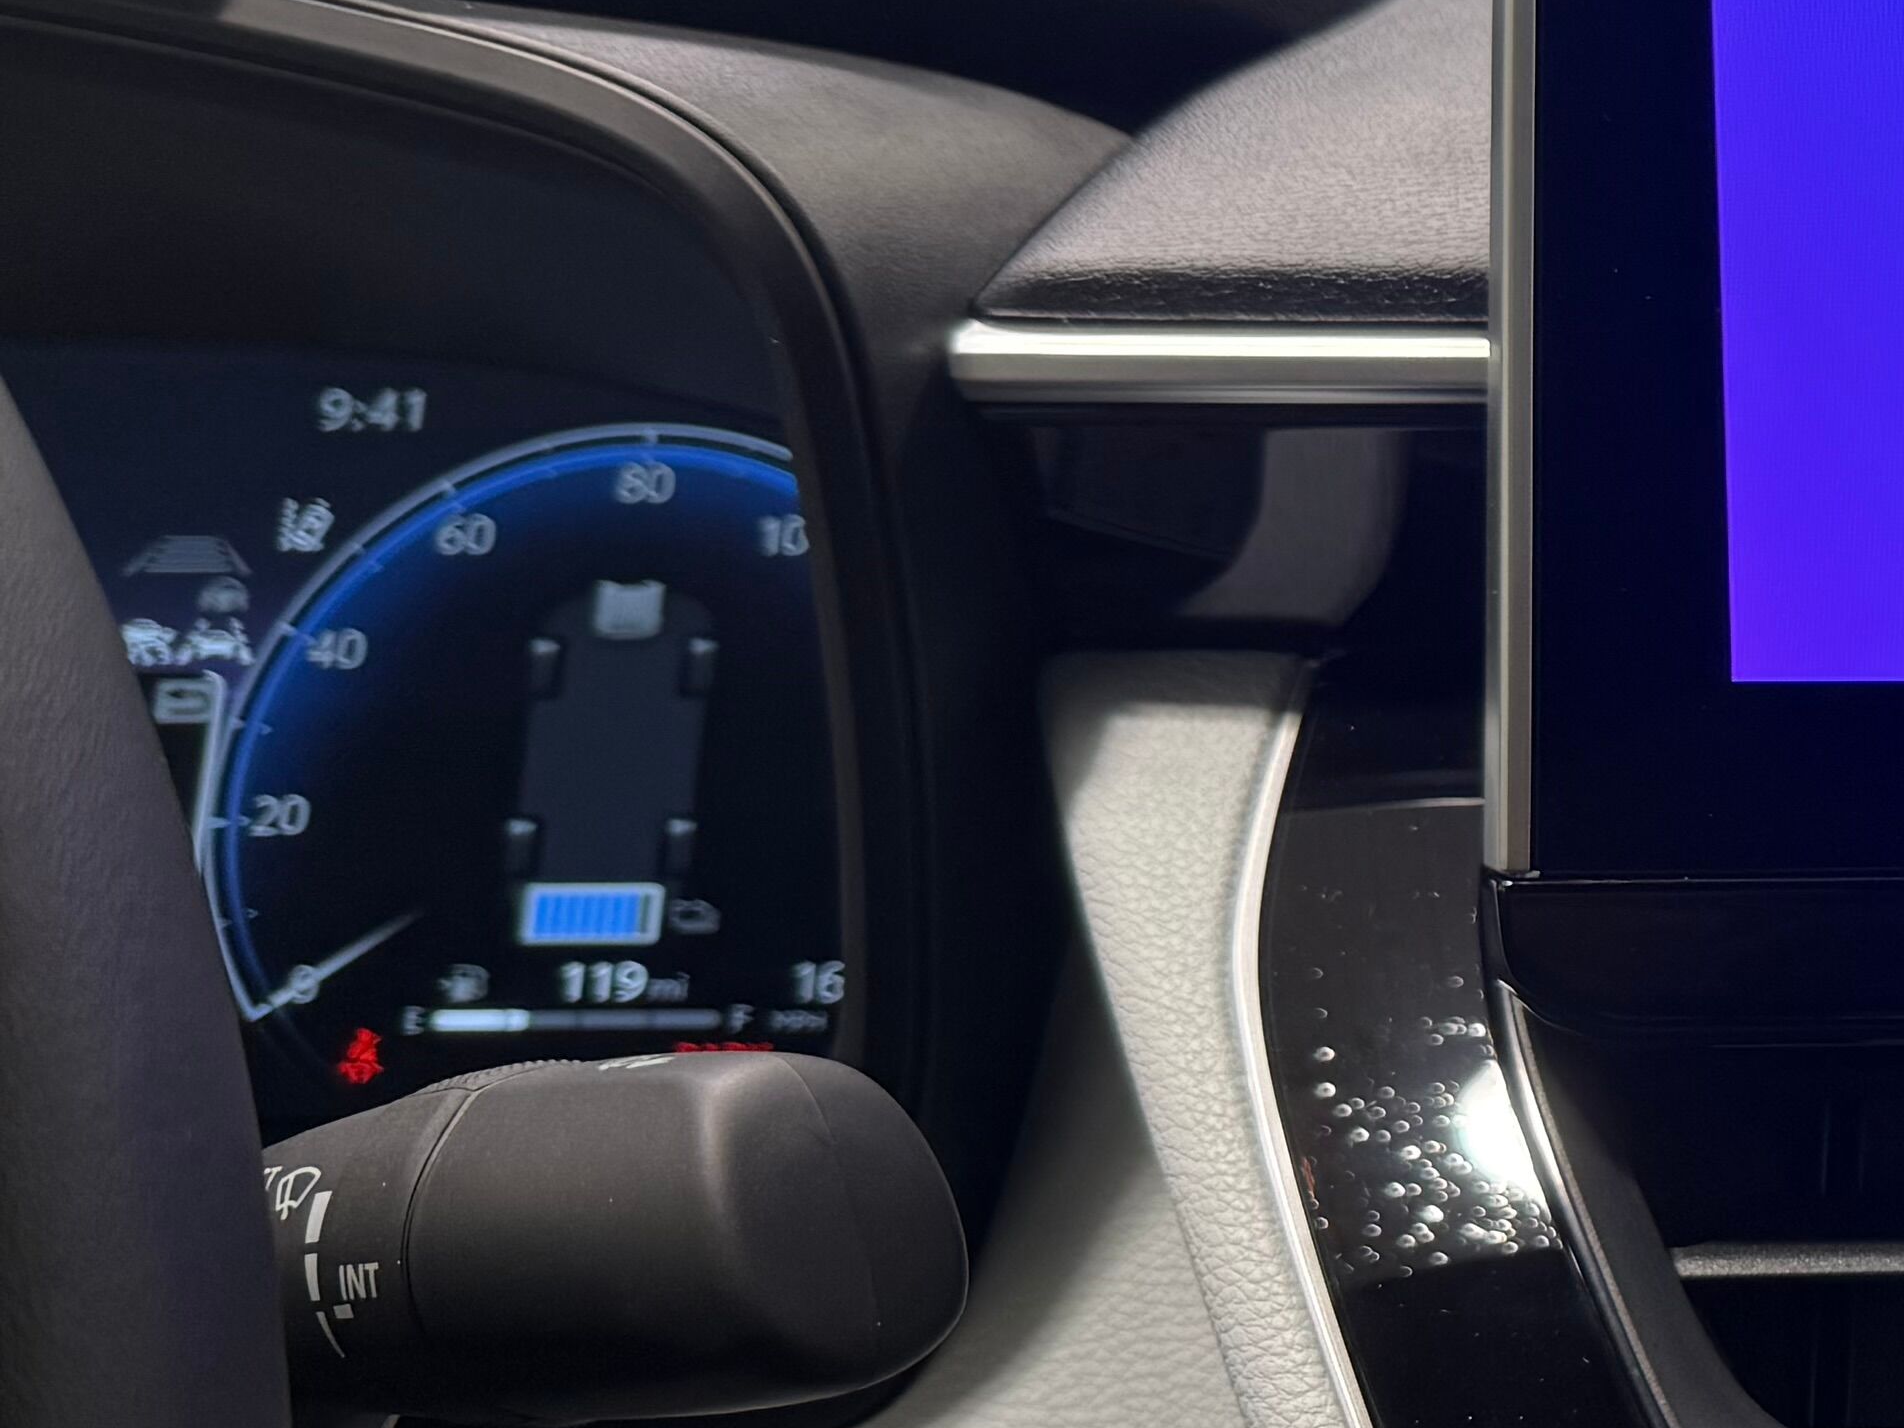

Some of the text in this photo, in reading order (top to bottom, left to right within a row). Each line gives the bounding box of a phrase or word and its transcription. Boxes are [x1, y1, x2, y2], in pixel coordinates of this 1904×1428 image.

[315, 386, 429, 434] 9:41
[612, 461, 678, 507] 80
[433, 512, 498, 558] 60
[303, 627, 370, 672] 40
[250, 793, 312, 837] 20
[338, 1261, 380, 1302] INT
